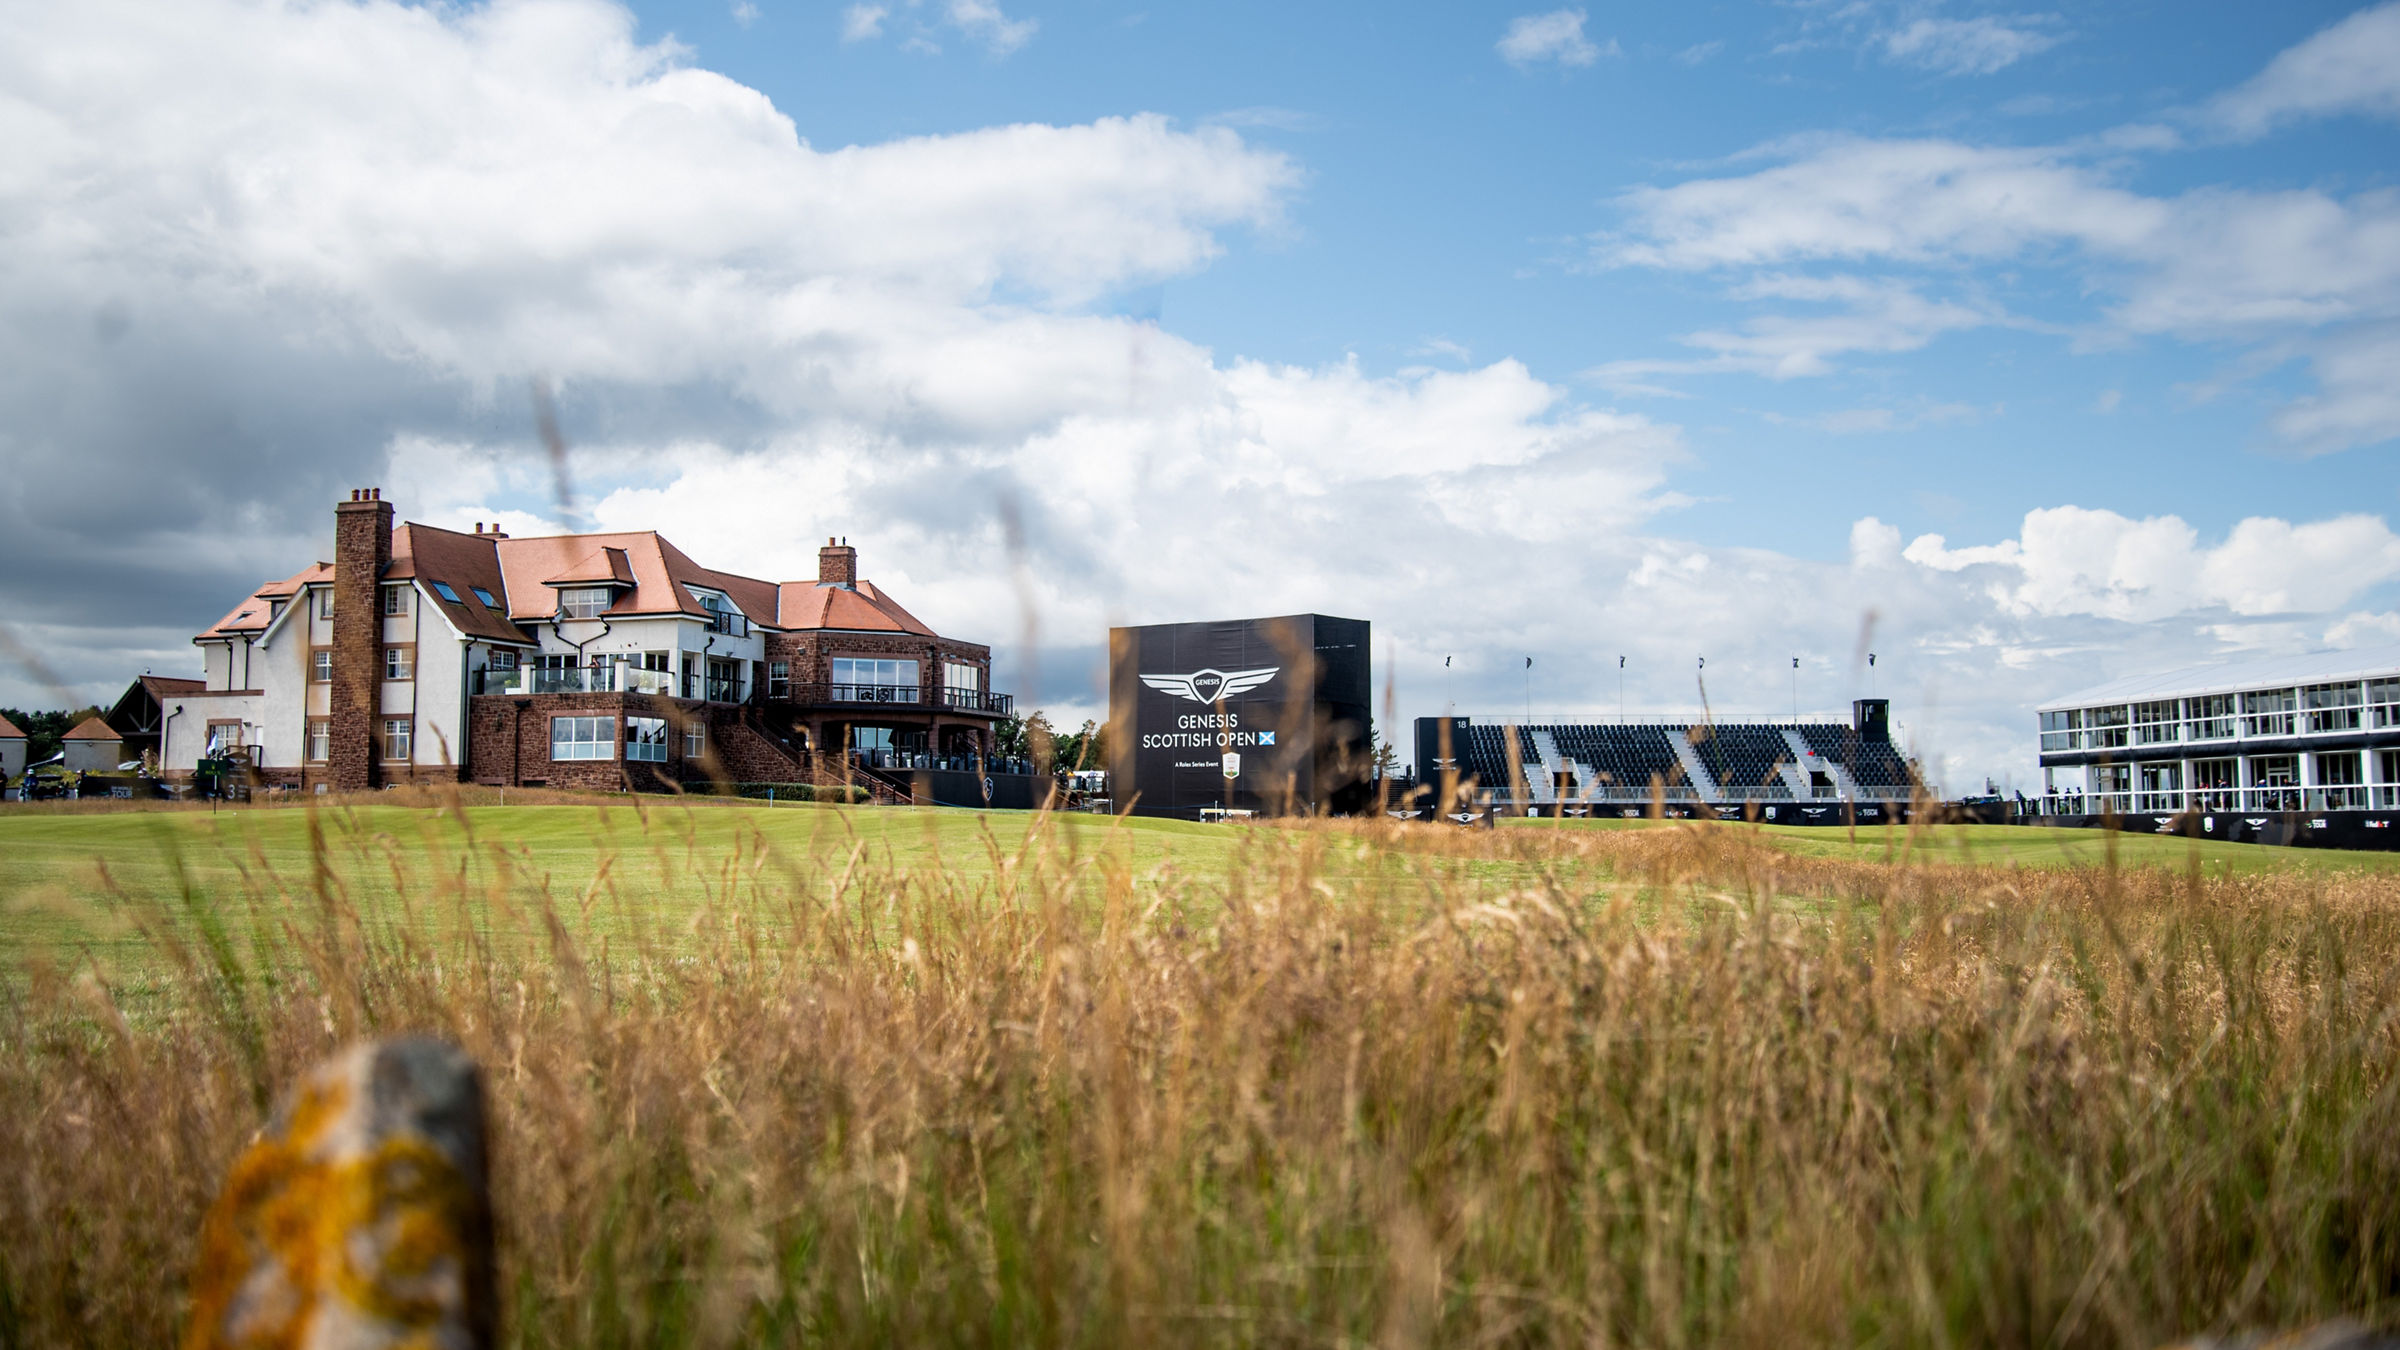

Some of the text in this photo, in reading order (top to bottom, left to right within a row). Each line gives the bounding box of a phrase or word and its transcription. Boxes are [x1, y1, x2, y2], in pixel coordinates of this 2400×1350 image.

[1195, 678, 1220, 686] GENESIS
[1178, 713, 1238, 729] GENESIS
[1457, 720, 1468, 729] 18
[1143, 732, 1256, 748] SCOTTISH OPEN
[112, 790, 133, 799] TOUR
[228, 784, 235, 799] 3
